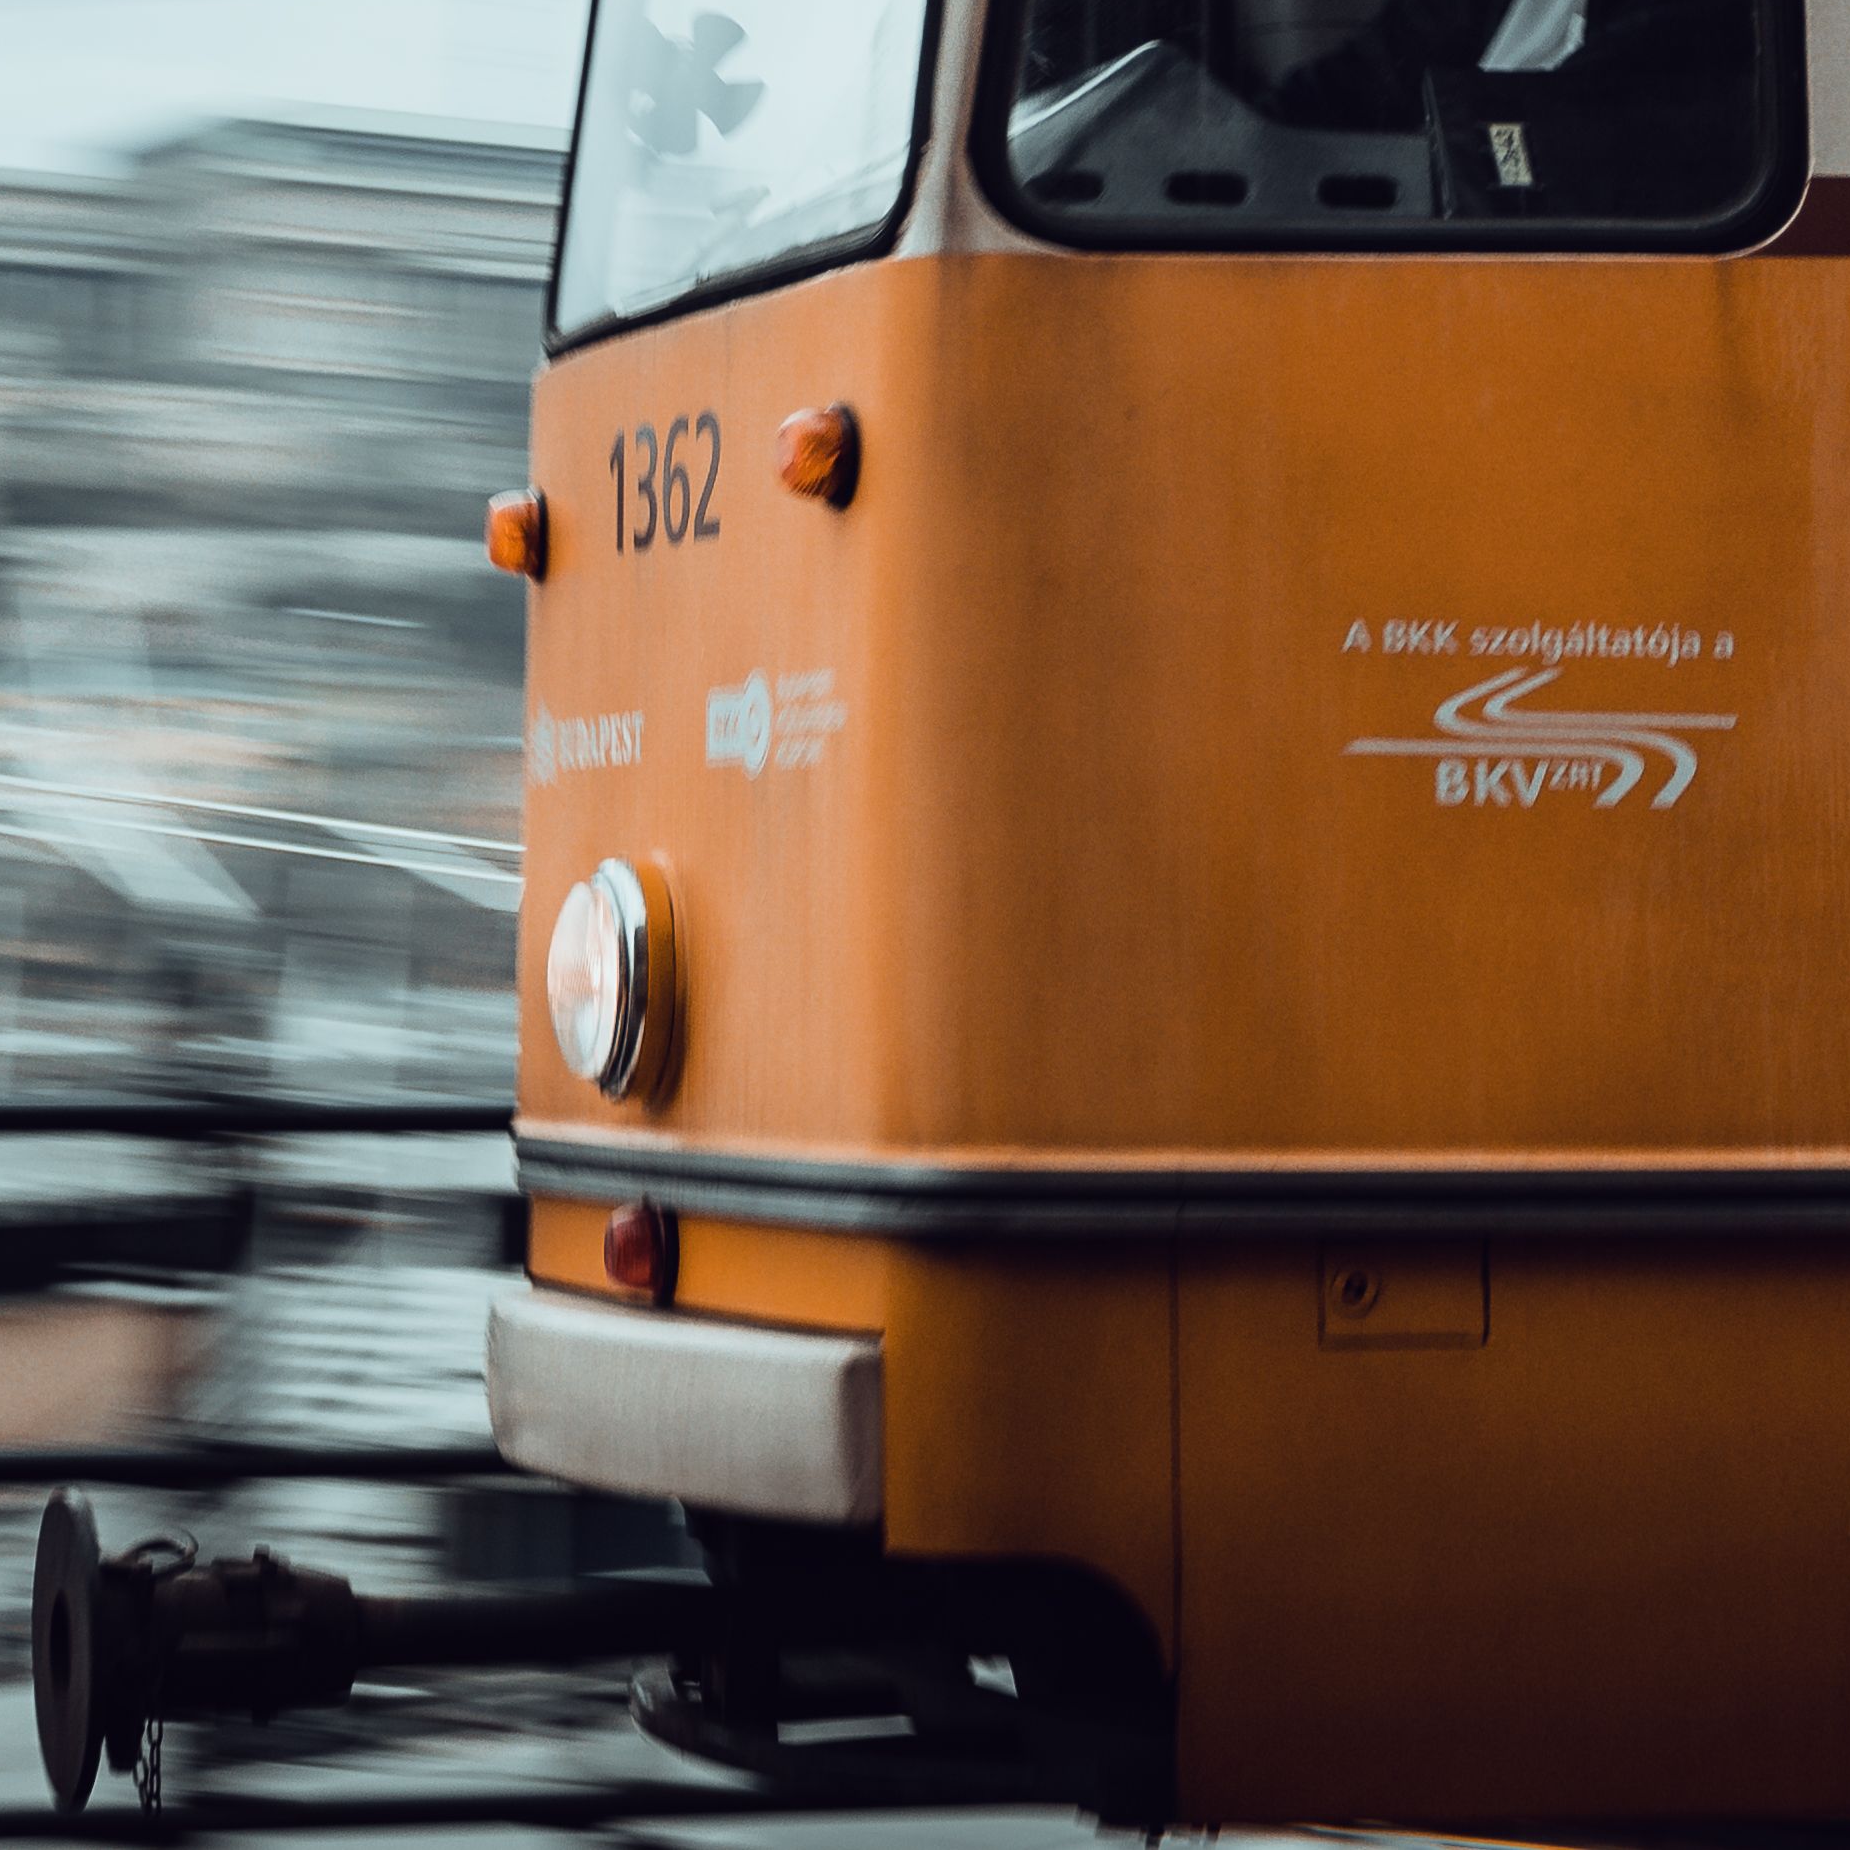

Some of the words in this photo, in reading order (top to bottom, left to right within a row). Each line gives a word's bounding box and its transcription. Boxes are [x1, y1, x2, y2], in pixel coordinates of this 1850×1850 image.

[609, 408, 721, 556] 1362
[1340, 618, 1372, 654] A
[1381, 618, 1460, 656] BKK
[1469, 618, 1702, 670] szolgáltatója
[1712, 629, 1735, 661] a
[1435, 756, 1550, 809] BKV
